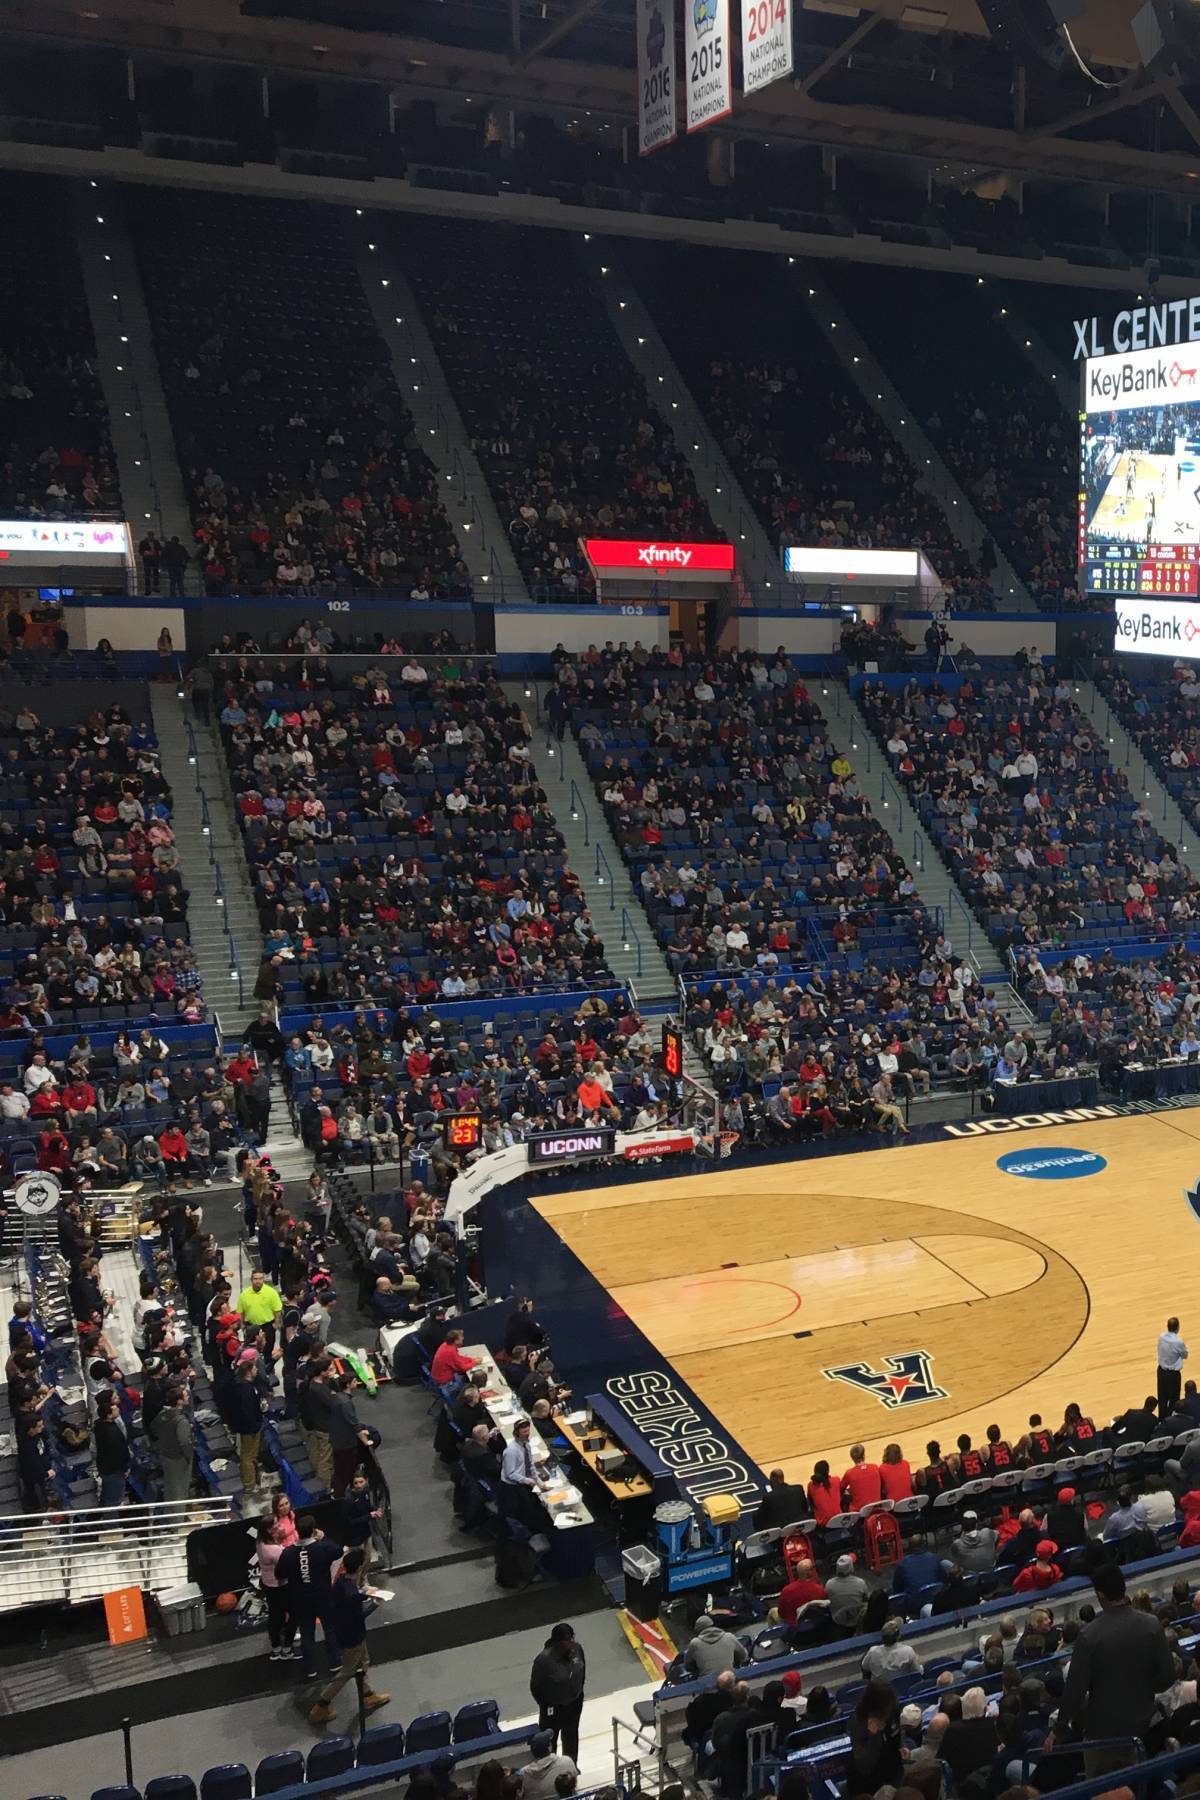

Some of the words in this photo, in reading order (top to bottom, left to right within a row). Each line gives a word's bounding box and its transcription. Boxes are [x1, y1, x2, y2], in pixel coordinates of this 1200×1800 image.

[748, 0, 786, 42] 2014
[691, 36, 722, 83] 2015
[750, 35, 784, 64] NATIONAL
[748, 54, 787, 85] CHAMPIONS
[693, 78, 722, 101] NATIONAL
[691, 96, 725, 122] CHAMPIONS
[1073, 318, 1104, 359] XL
[1091, 360, 1167, 400] KeyBank
[637, 546, 692, 566] xfinity
[327, 601, 350, 612] 102
[621, 605, 643, 616] 103
[944, 1105, 1118, 1137] UCONN
[453, 1128, 472, 1143] 23
[541, 1136, 602, 1155] UCONN
[1007, 1153, 1098, 1174] genius3D
[607, 1371, 763, 1513] HUSKIES
[1077, 1425, 1093, 1439] 23
[994, 1450, 1010, 1465] 25
[1039, 1439, 1049, 1453] 3
[965, 1461, 981, 1475] 55
[299, 1551, 310, 1583] UCONN
